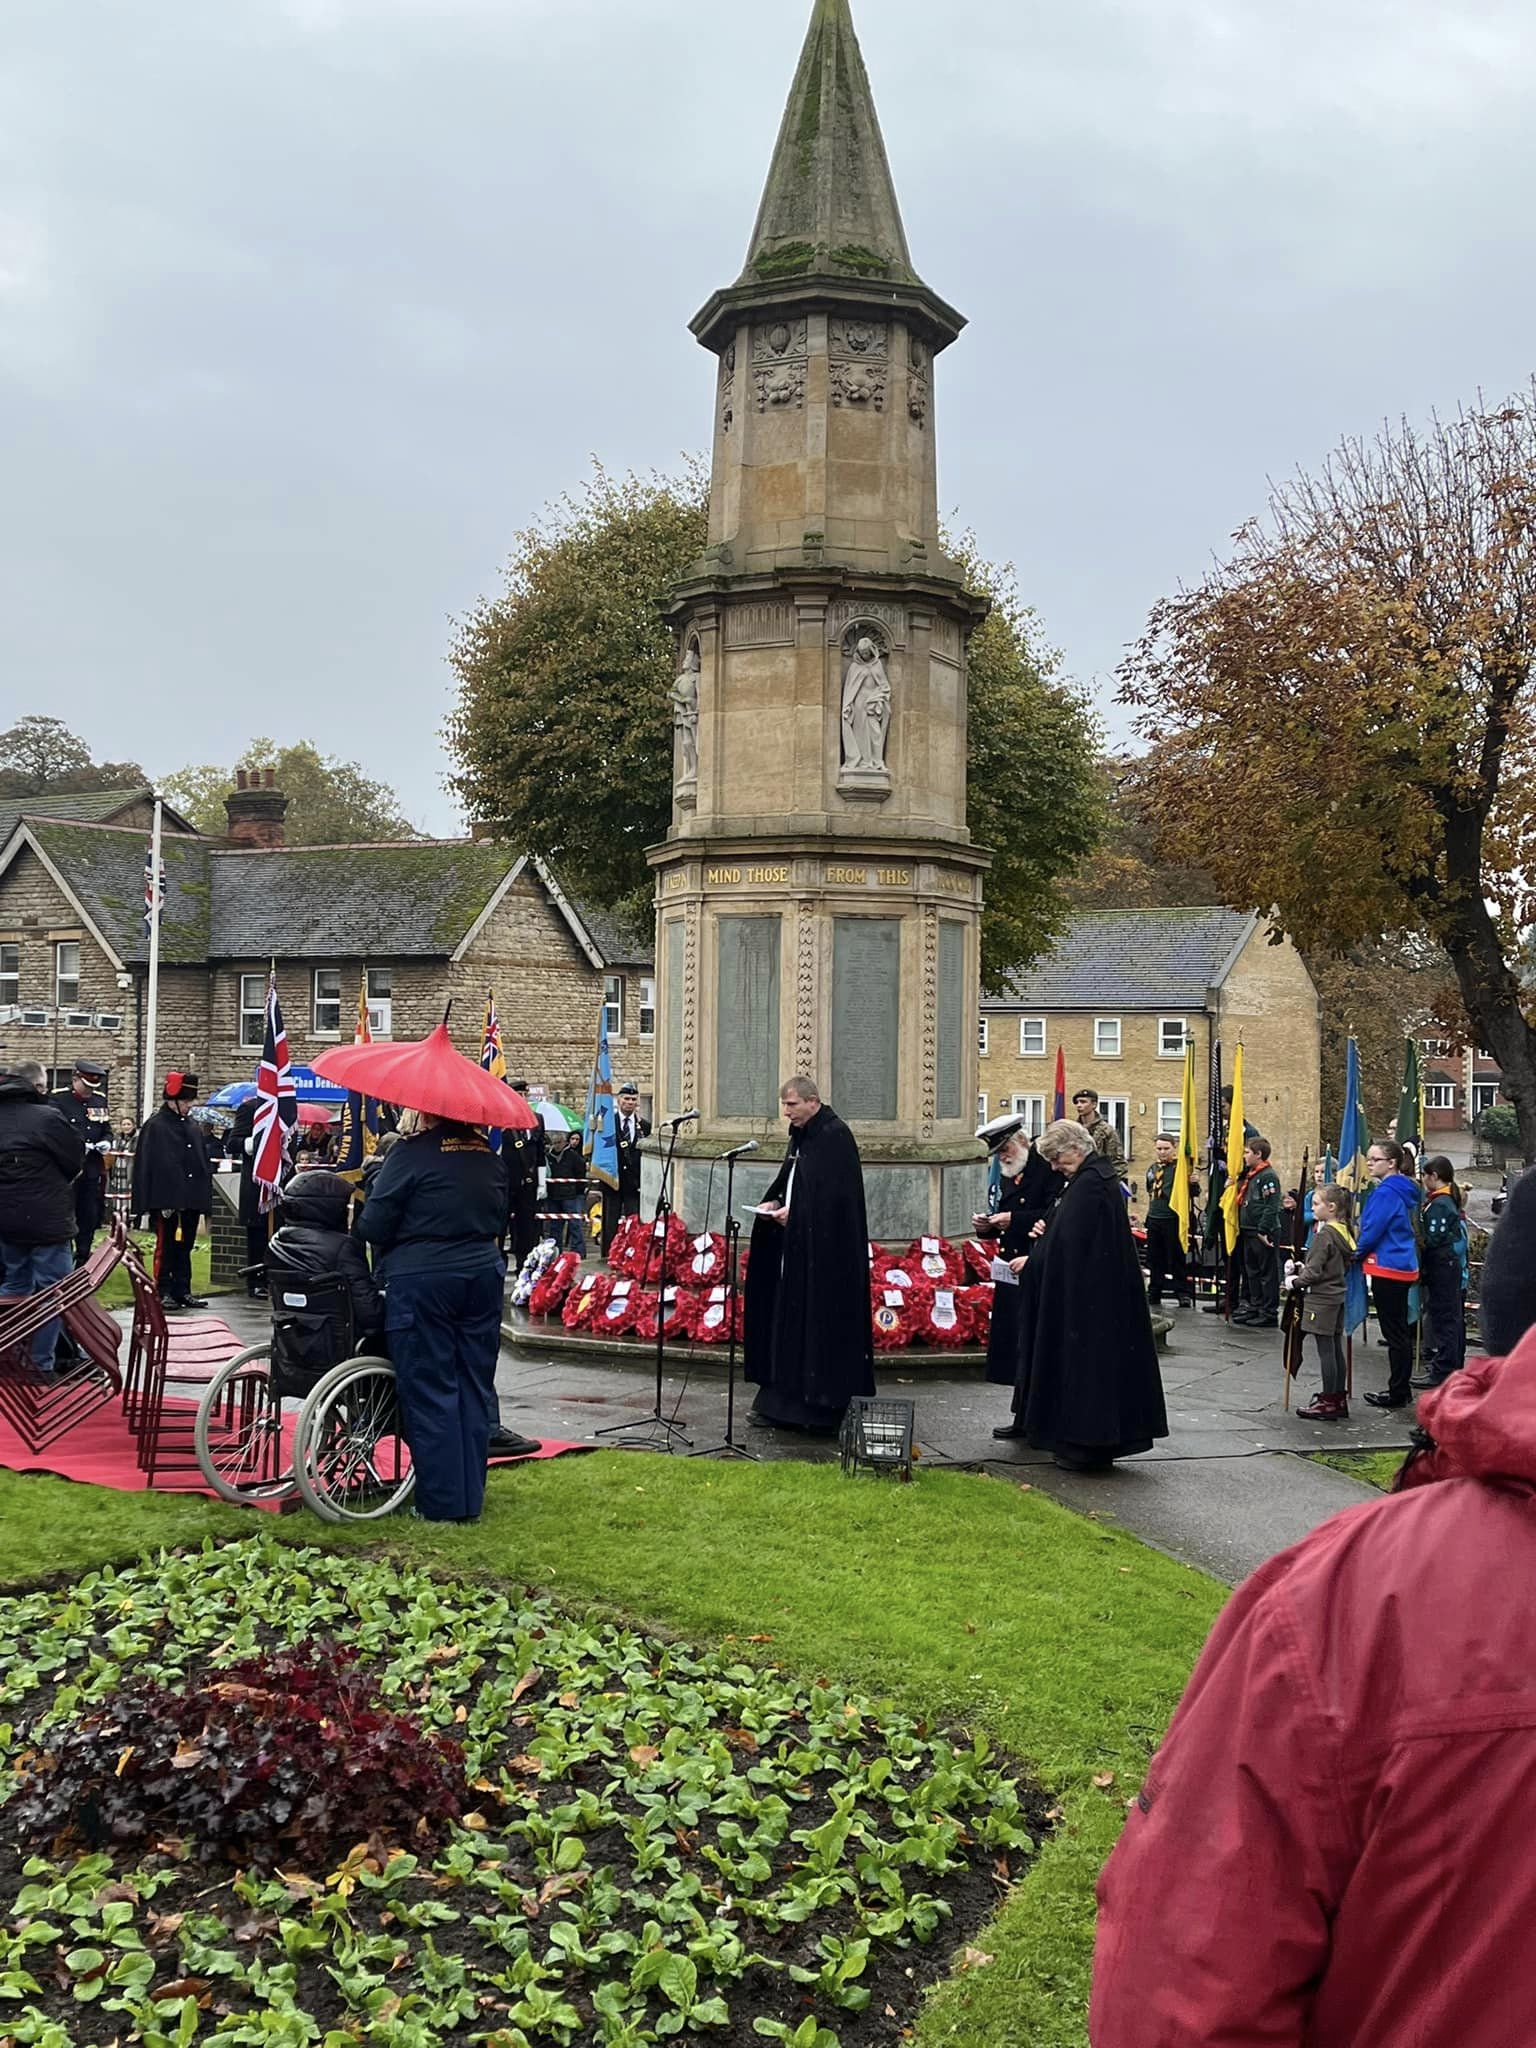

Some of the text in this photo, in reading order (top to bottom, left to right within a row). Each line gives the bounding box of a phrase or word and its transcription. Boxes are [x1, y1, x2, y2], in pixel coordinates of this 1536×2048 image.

[708, 866, 788, 884] MIND THOSE
[826, 867, 910, 885] FROM THIS
[315, 1076, 343, 1089] Dent
[337, 1135, 352, 1164] NAVAL
